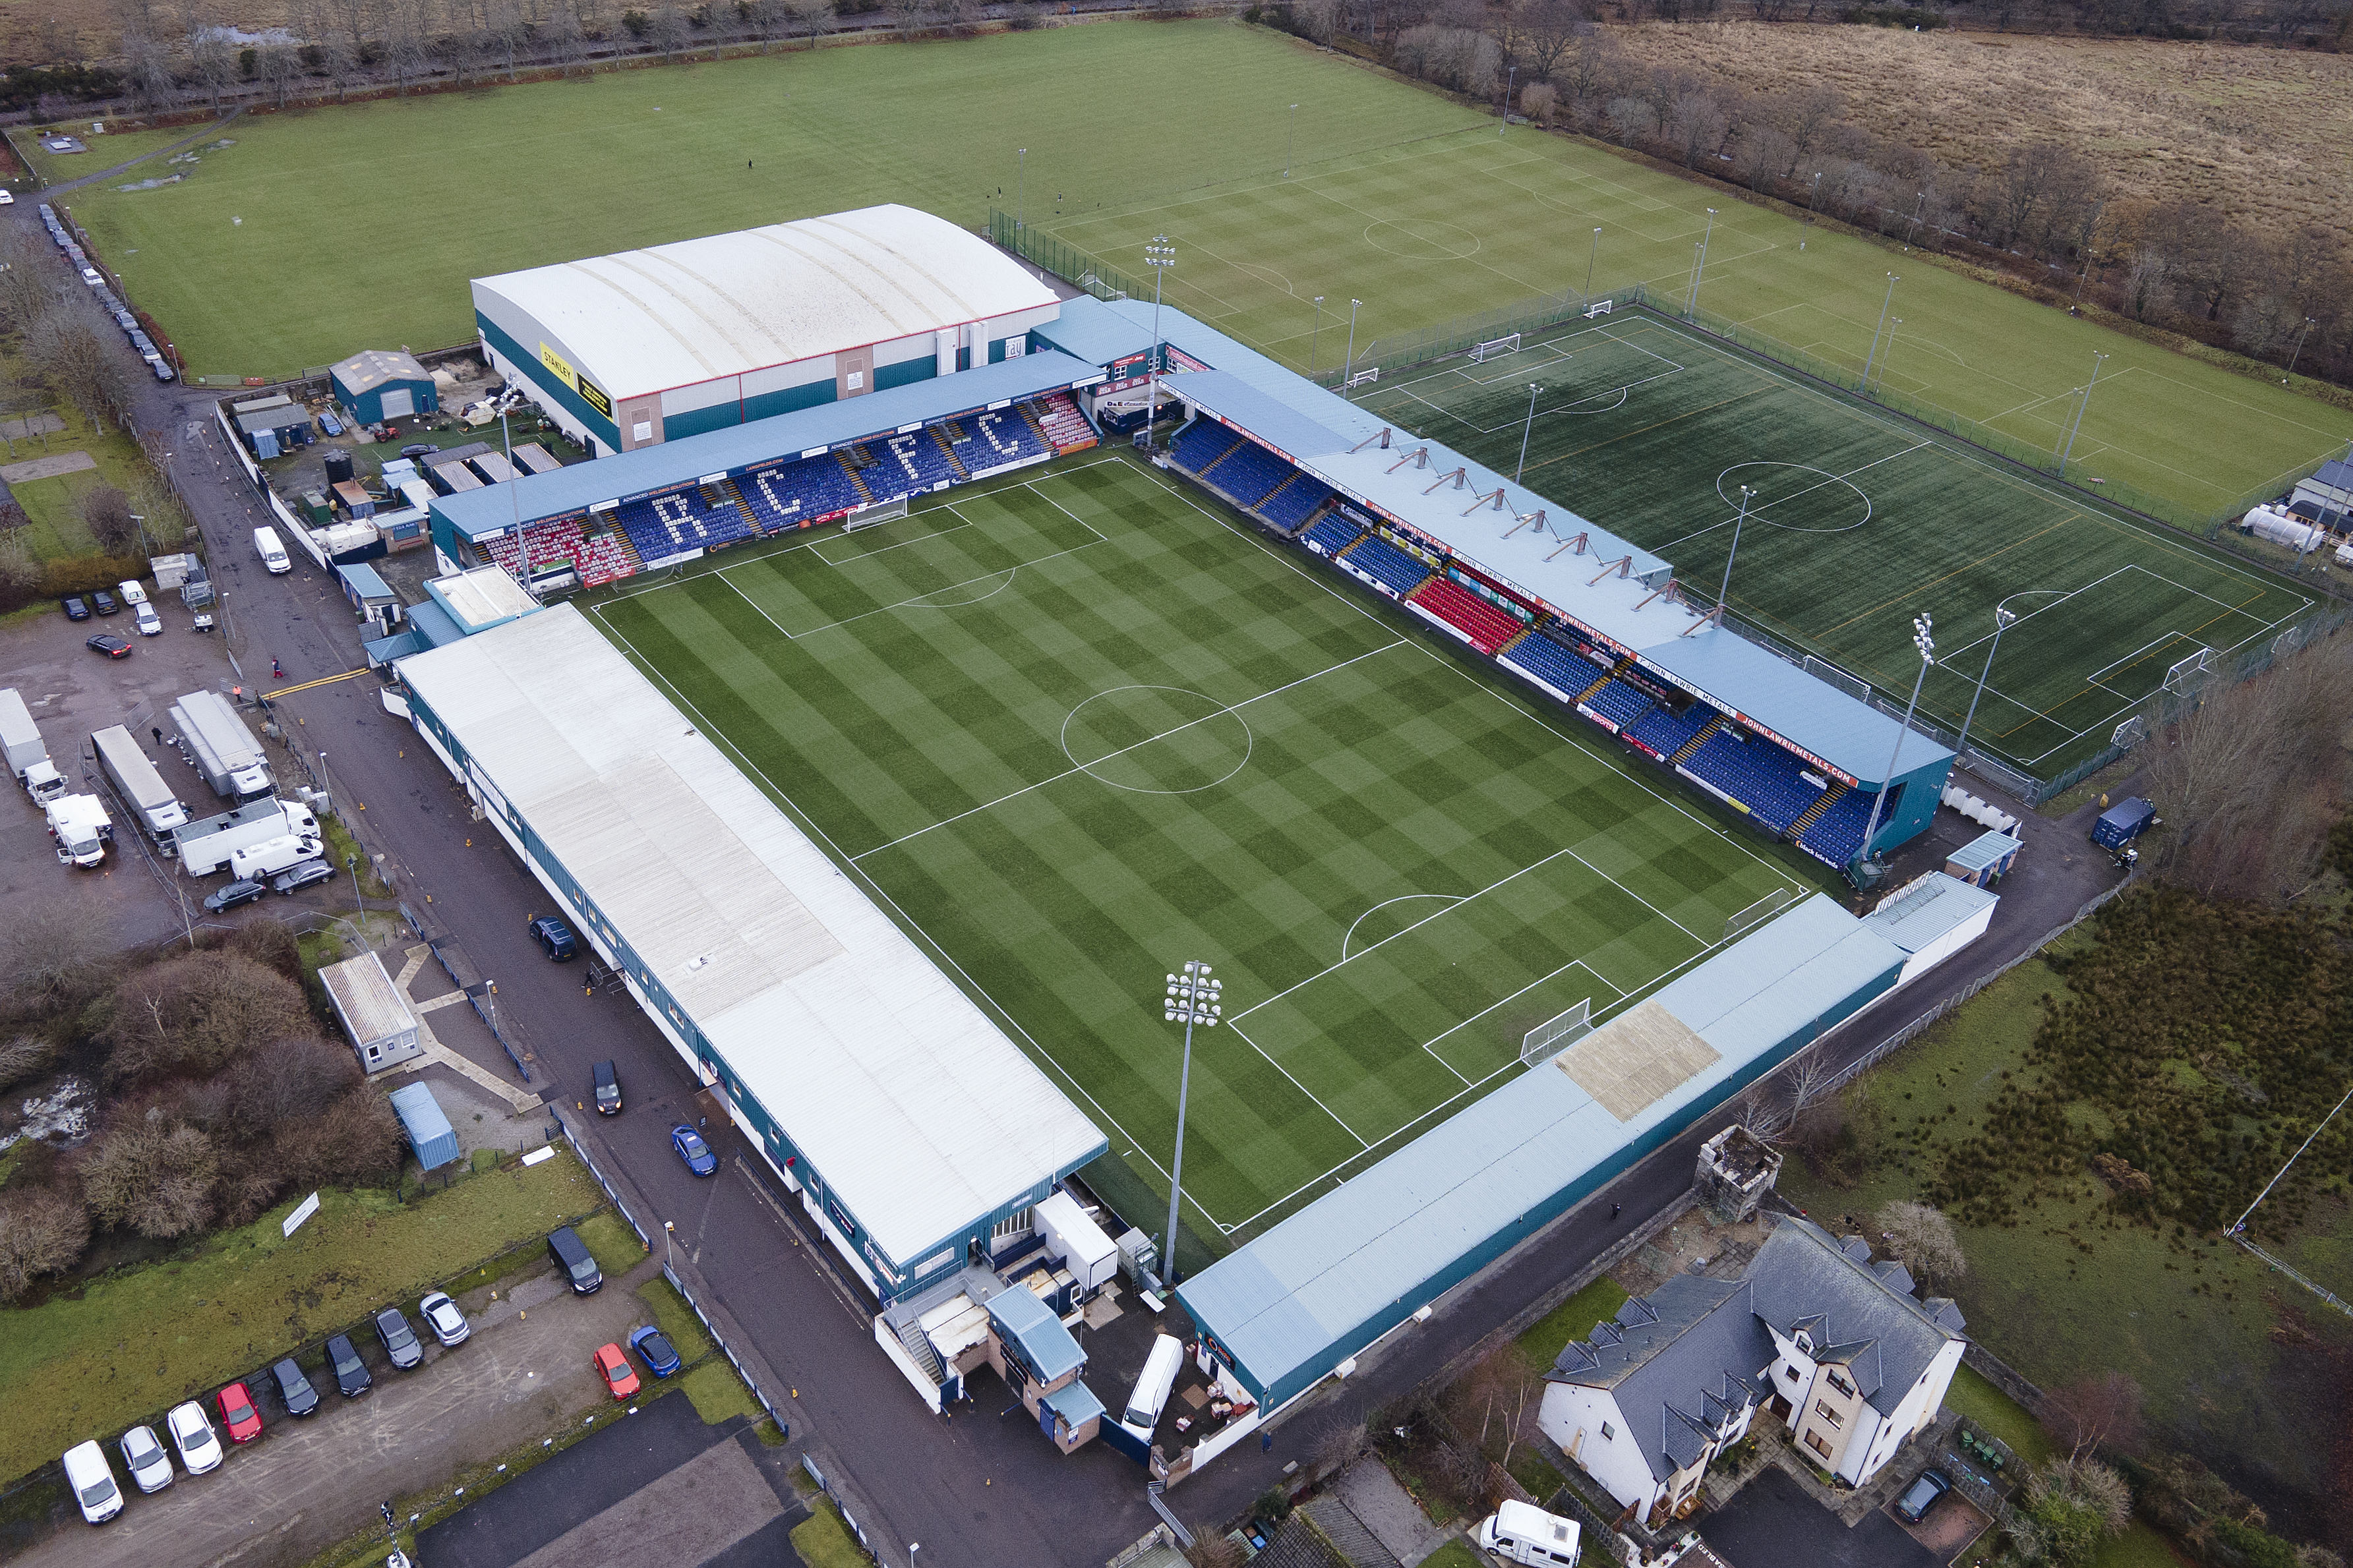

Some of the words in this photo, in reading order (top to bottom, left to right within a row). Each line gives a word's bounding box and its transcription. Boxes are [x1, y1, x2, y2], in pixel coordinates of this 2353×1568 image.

[544, 351, 571, 379] STANLEY
[1013, 394, 1033, 403] ADVANCED
[1199, 405, 1218, 419] METALS
[925, 417, 946, 426] ADVANCED
[946, 411, 964, 420] WELDING
[963, 407, 985, 416] SOLUTIONS
[831, 440, 853, 450] ADVANCED
[853, 435, 872, 444] WELDING
[872, 430, 895, 440] SOLUTIONS
[1225, 419, 1292, 461] JOHNLAWRIEMETALS.COM
[622, 492, 649, 503] ADVANCED
[649, 486, 670, 496] WELDING
[670, 480, 696, 491] SOLUTIONS
[1302, 463, 1315, 475] JOHN
[1319, 473, 1339, 489] LAWRIE
[1342, 484, 1364, 503] METALS
[508, 521, 535, 532] ADVNCED
[535, 515, 558, 525] WELDING
[558, 508, 585, 519] SOLUTIONS
[1370, 504, 1447, 551] JOHNLAWRIEMETALS.COM
[1460, 555, 1476, 567] JOHN
[1479, 564, 1504, 583] LAWRIE
[1507, 581, 1532, 600] METALS
[1541, 600, 1632, 658] JOHNLAWRIEMETALS.COM
[1647, 663, 1666, 677] JOHN
[1670, 674, 1698, 695] LAWRIE
[1702, 693, 1732, 714] METALS
[1592, 715, 1613, 731] sports
[1742, 716, 1851, 783] JOHNLAWRIEMETALS.COM
[1800, 842, 1814, 855] black
[1825, 857, 1838, 869] beds
